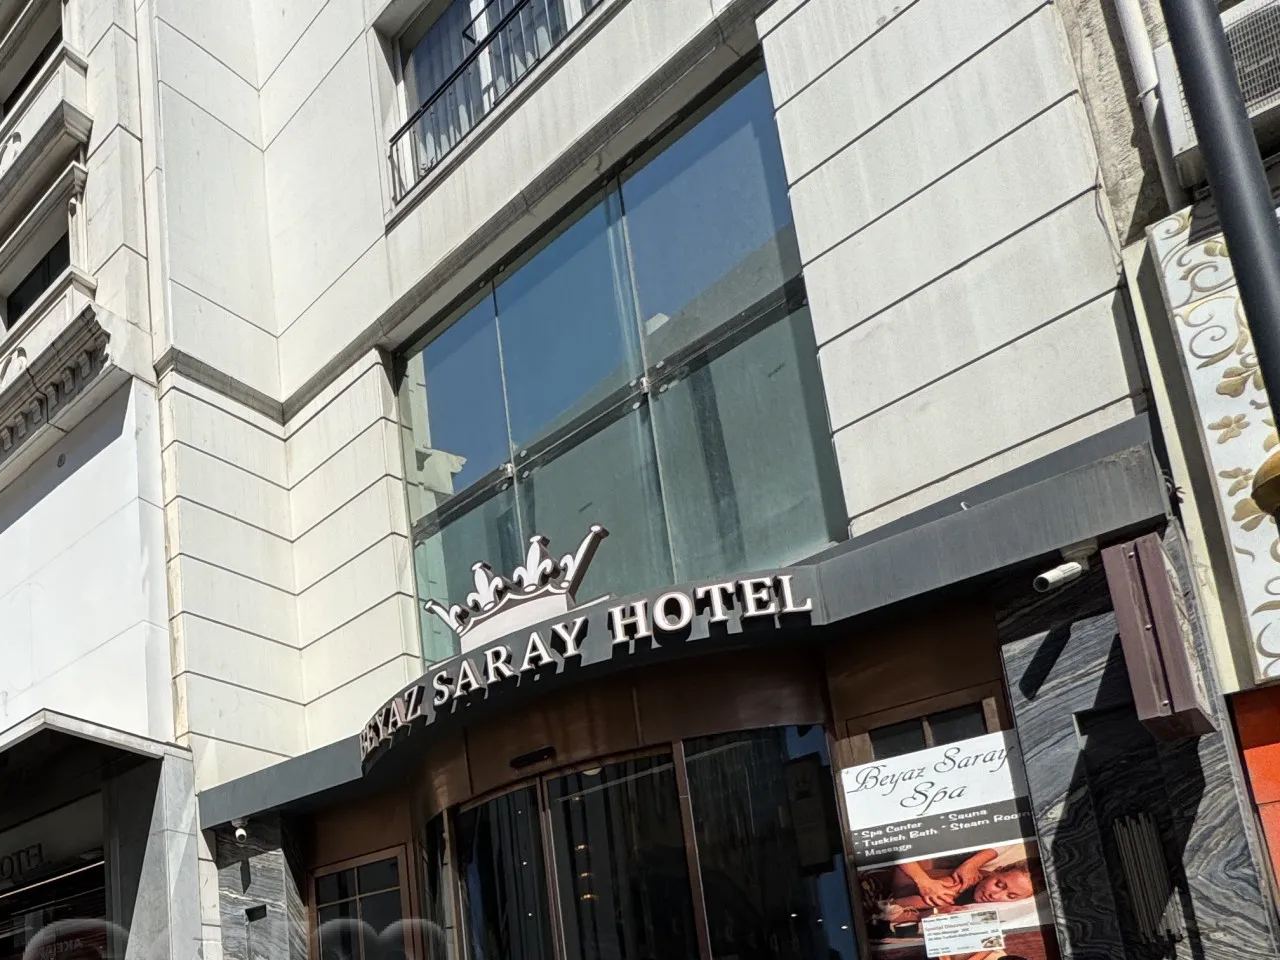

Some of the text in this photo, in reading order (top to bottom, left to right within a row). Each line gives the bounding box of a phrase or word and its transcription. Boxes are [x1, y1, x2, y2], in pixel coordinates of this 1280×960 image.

[359, 575, 813, 761] BEYAZ SARAY HOTEL
[847, 746, 1015, 797] Beyaz Saray
[899, 781, 968, 817] Spa
[948, 809, 988, 822] Sauna
[861, 822, 923, 839] Spa Center
[949, 819, 990, 831] Steam
[909, 828, 938, 840] Bath
